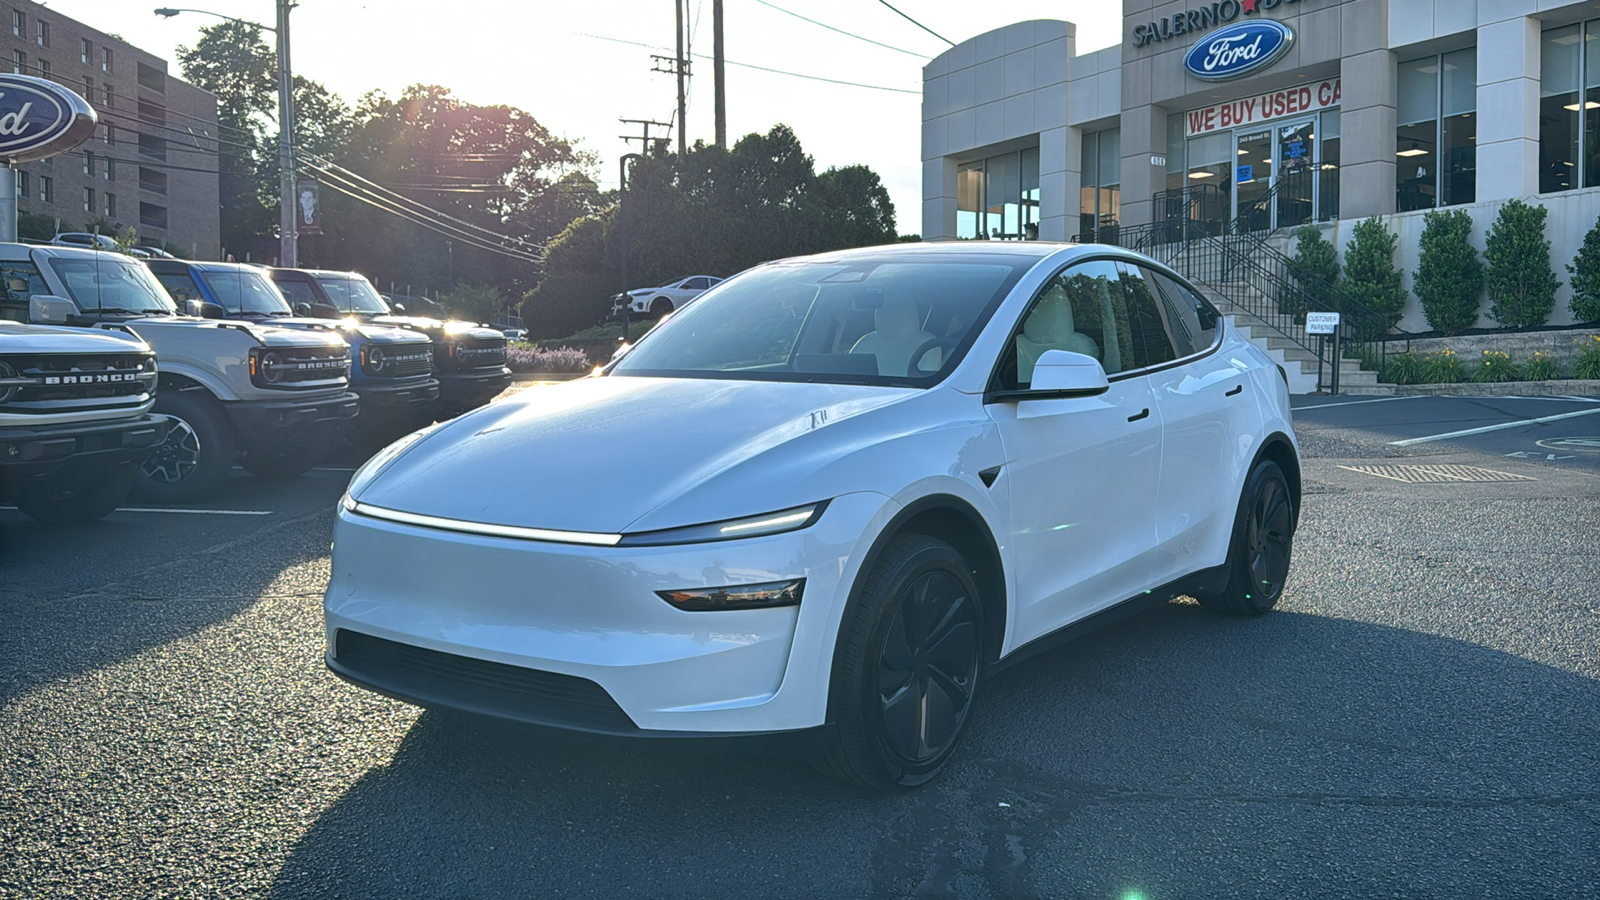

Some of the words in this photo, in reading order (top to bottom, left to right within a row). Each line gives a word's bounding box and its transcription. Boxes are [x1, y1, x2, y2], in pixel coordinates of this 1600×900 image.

[1132, 0, 1241, 47] SALERNO
[1203, 32, 1263, 71] Ford
[1188, 108, 1215, 134] WE
[1220, 98, 1257, 128] BUY
[1261, 87, 1312, 119] USED
[1308, 315, 1337, 323] CUSTOMER
[298, 361, 345, 370] BRONCO
[45, 373, 136, 385] BRONCO
